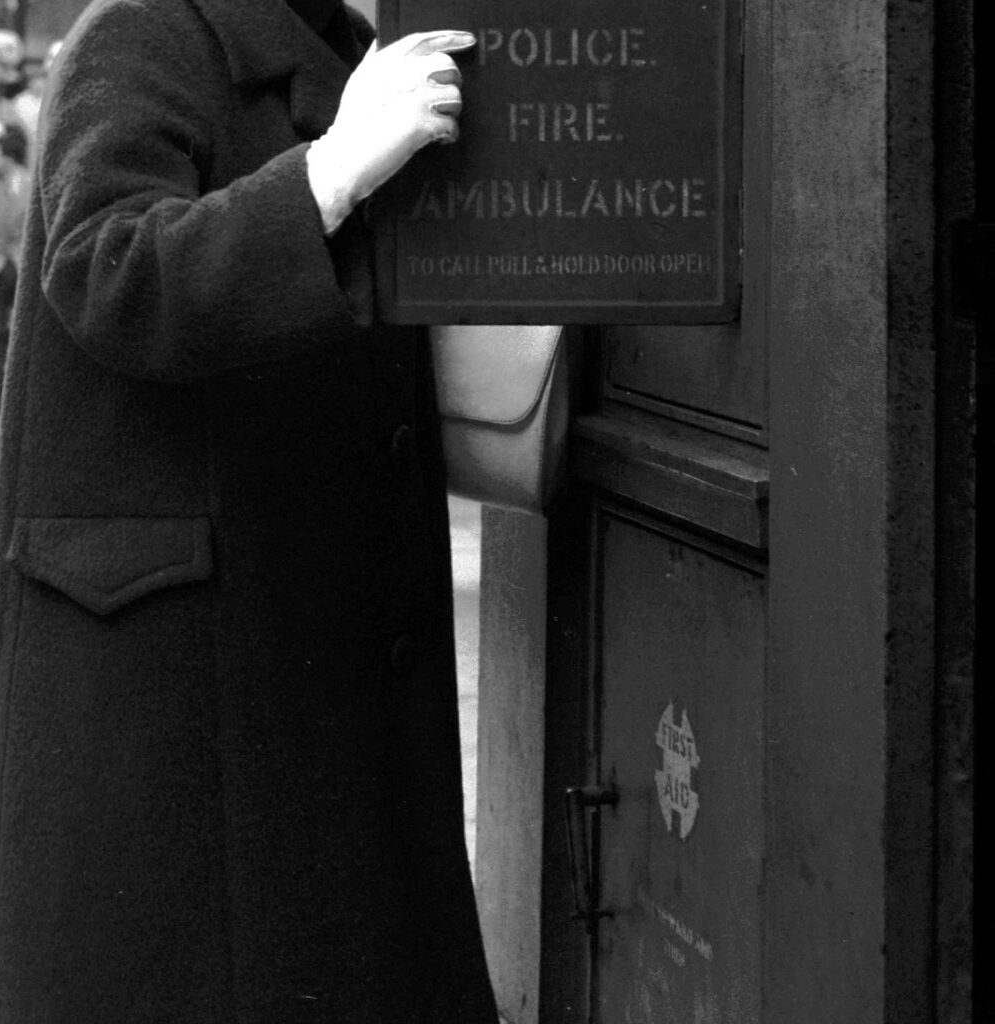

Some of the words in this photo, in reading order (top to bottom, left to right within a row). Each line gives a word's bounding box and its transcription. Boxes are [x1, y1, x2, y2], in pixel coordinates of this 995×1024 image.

[477, 27, 657, 66] POLICE.
[509, 102, 624, 142] FIRE.
[407, 255, 434, 275] TO
[535, 255, 547, 274] &
[551, 254, 600, 275] HOLD
[604, 253, 655, 274] DOOR
[661, 721, 694, 762] FIRST
[664, 773, 690, 809] AID
